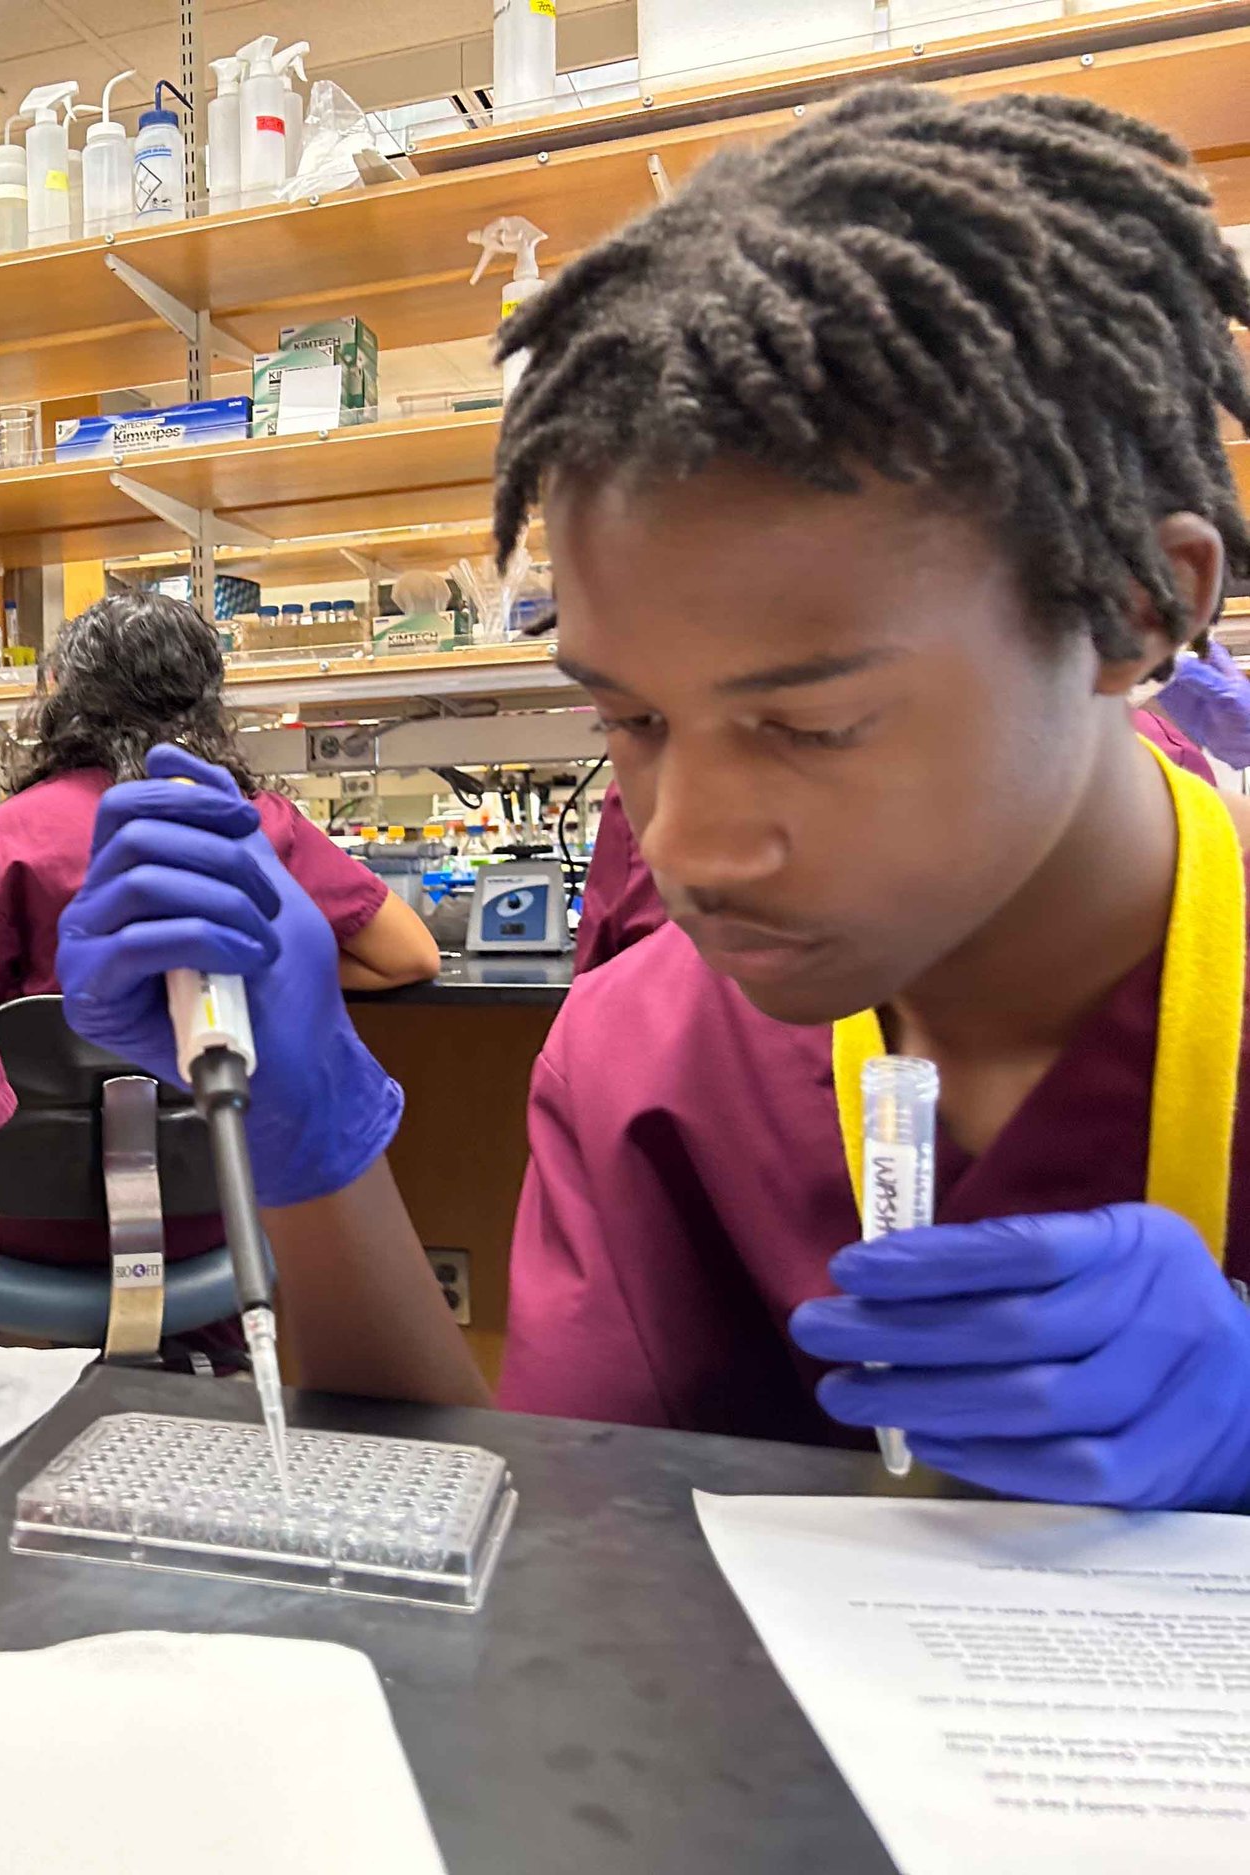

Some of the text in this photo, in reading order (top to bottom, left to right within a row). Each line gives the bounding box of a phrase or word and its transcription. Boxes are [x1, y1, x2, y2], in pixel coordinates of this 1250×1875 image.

[293, 336, 341, 351] KIMTECH
[113, 426, 181, 444] Kimwipes
[388, 632, 439, 645] KIMTECH
[872, 1156, 898, 1232] WASH
